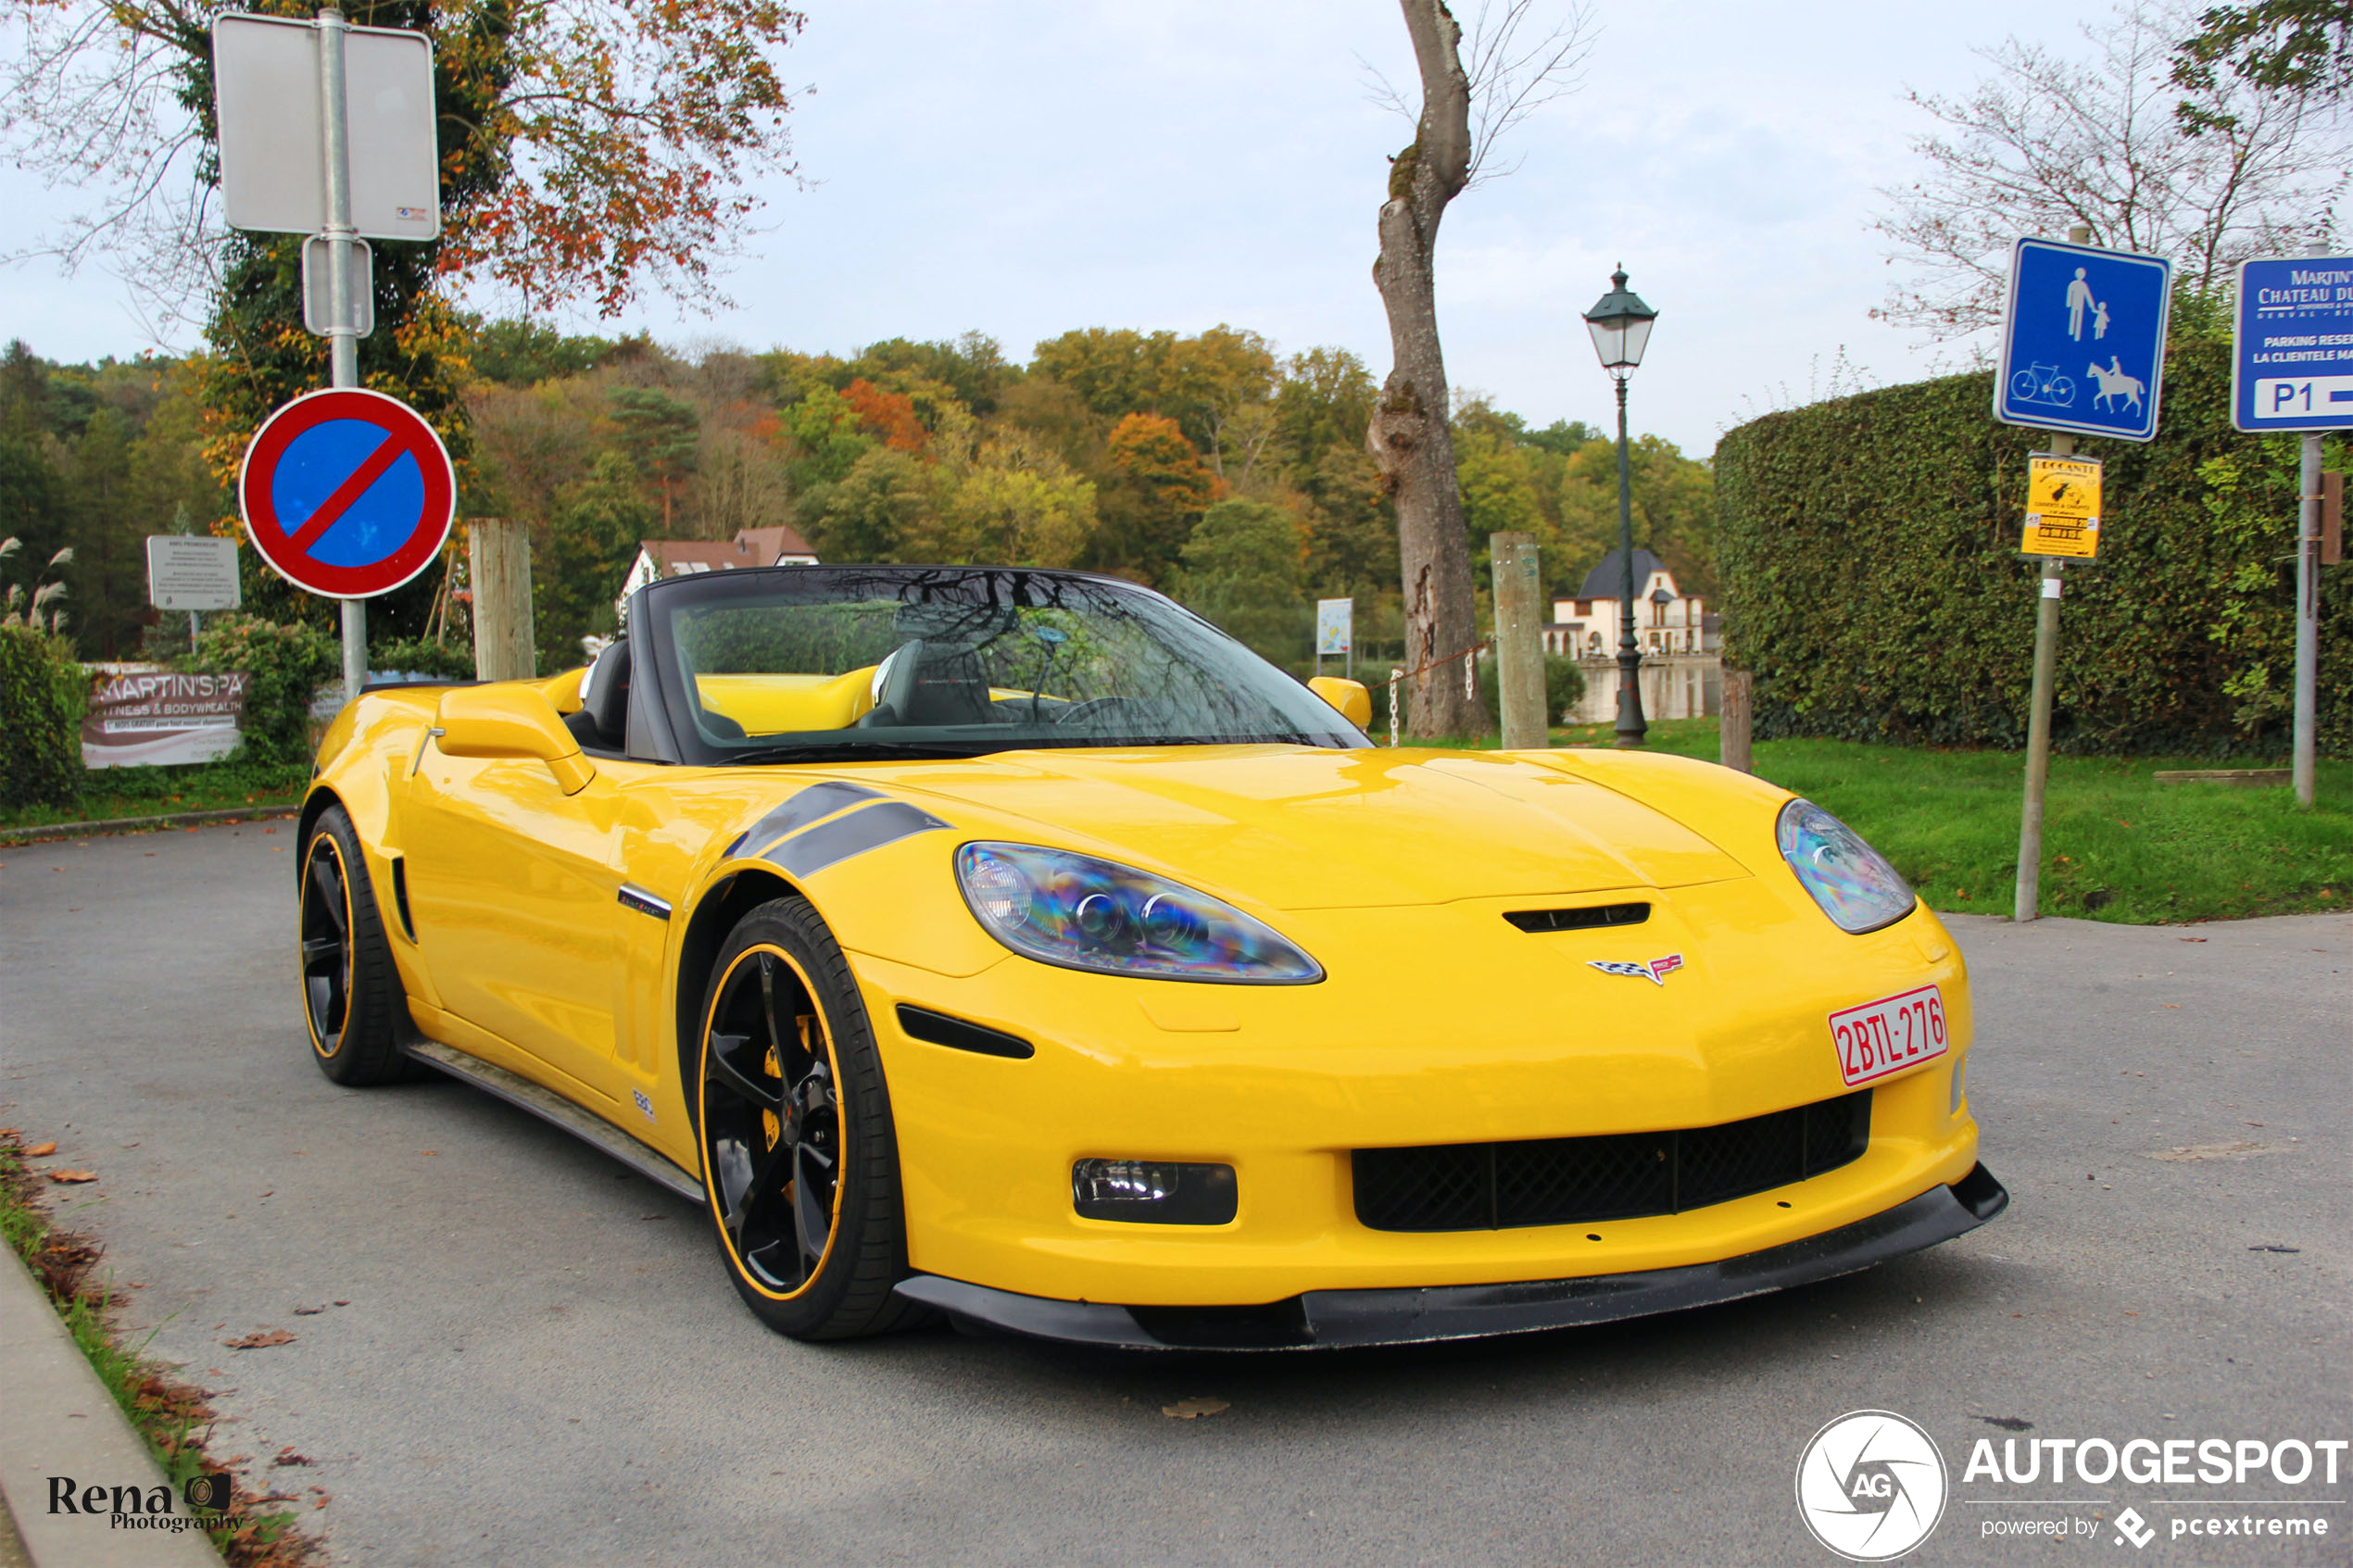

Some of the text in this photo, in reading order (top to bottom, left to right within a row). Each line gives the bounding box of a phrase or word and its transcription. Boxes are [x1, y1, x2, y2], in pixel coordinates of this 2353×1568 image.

[2259, 287, 2330, 304] CHATEAU
[2264, 335, 2318, 347] PARKING
[2253, 353, 2270, 364] LA
[2271, 350, 2336, 362] CLIENTELE
[2273, 382, 2312, 413] P1
[153, 703, 161, 715] &
